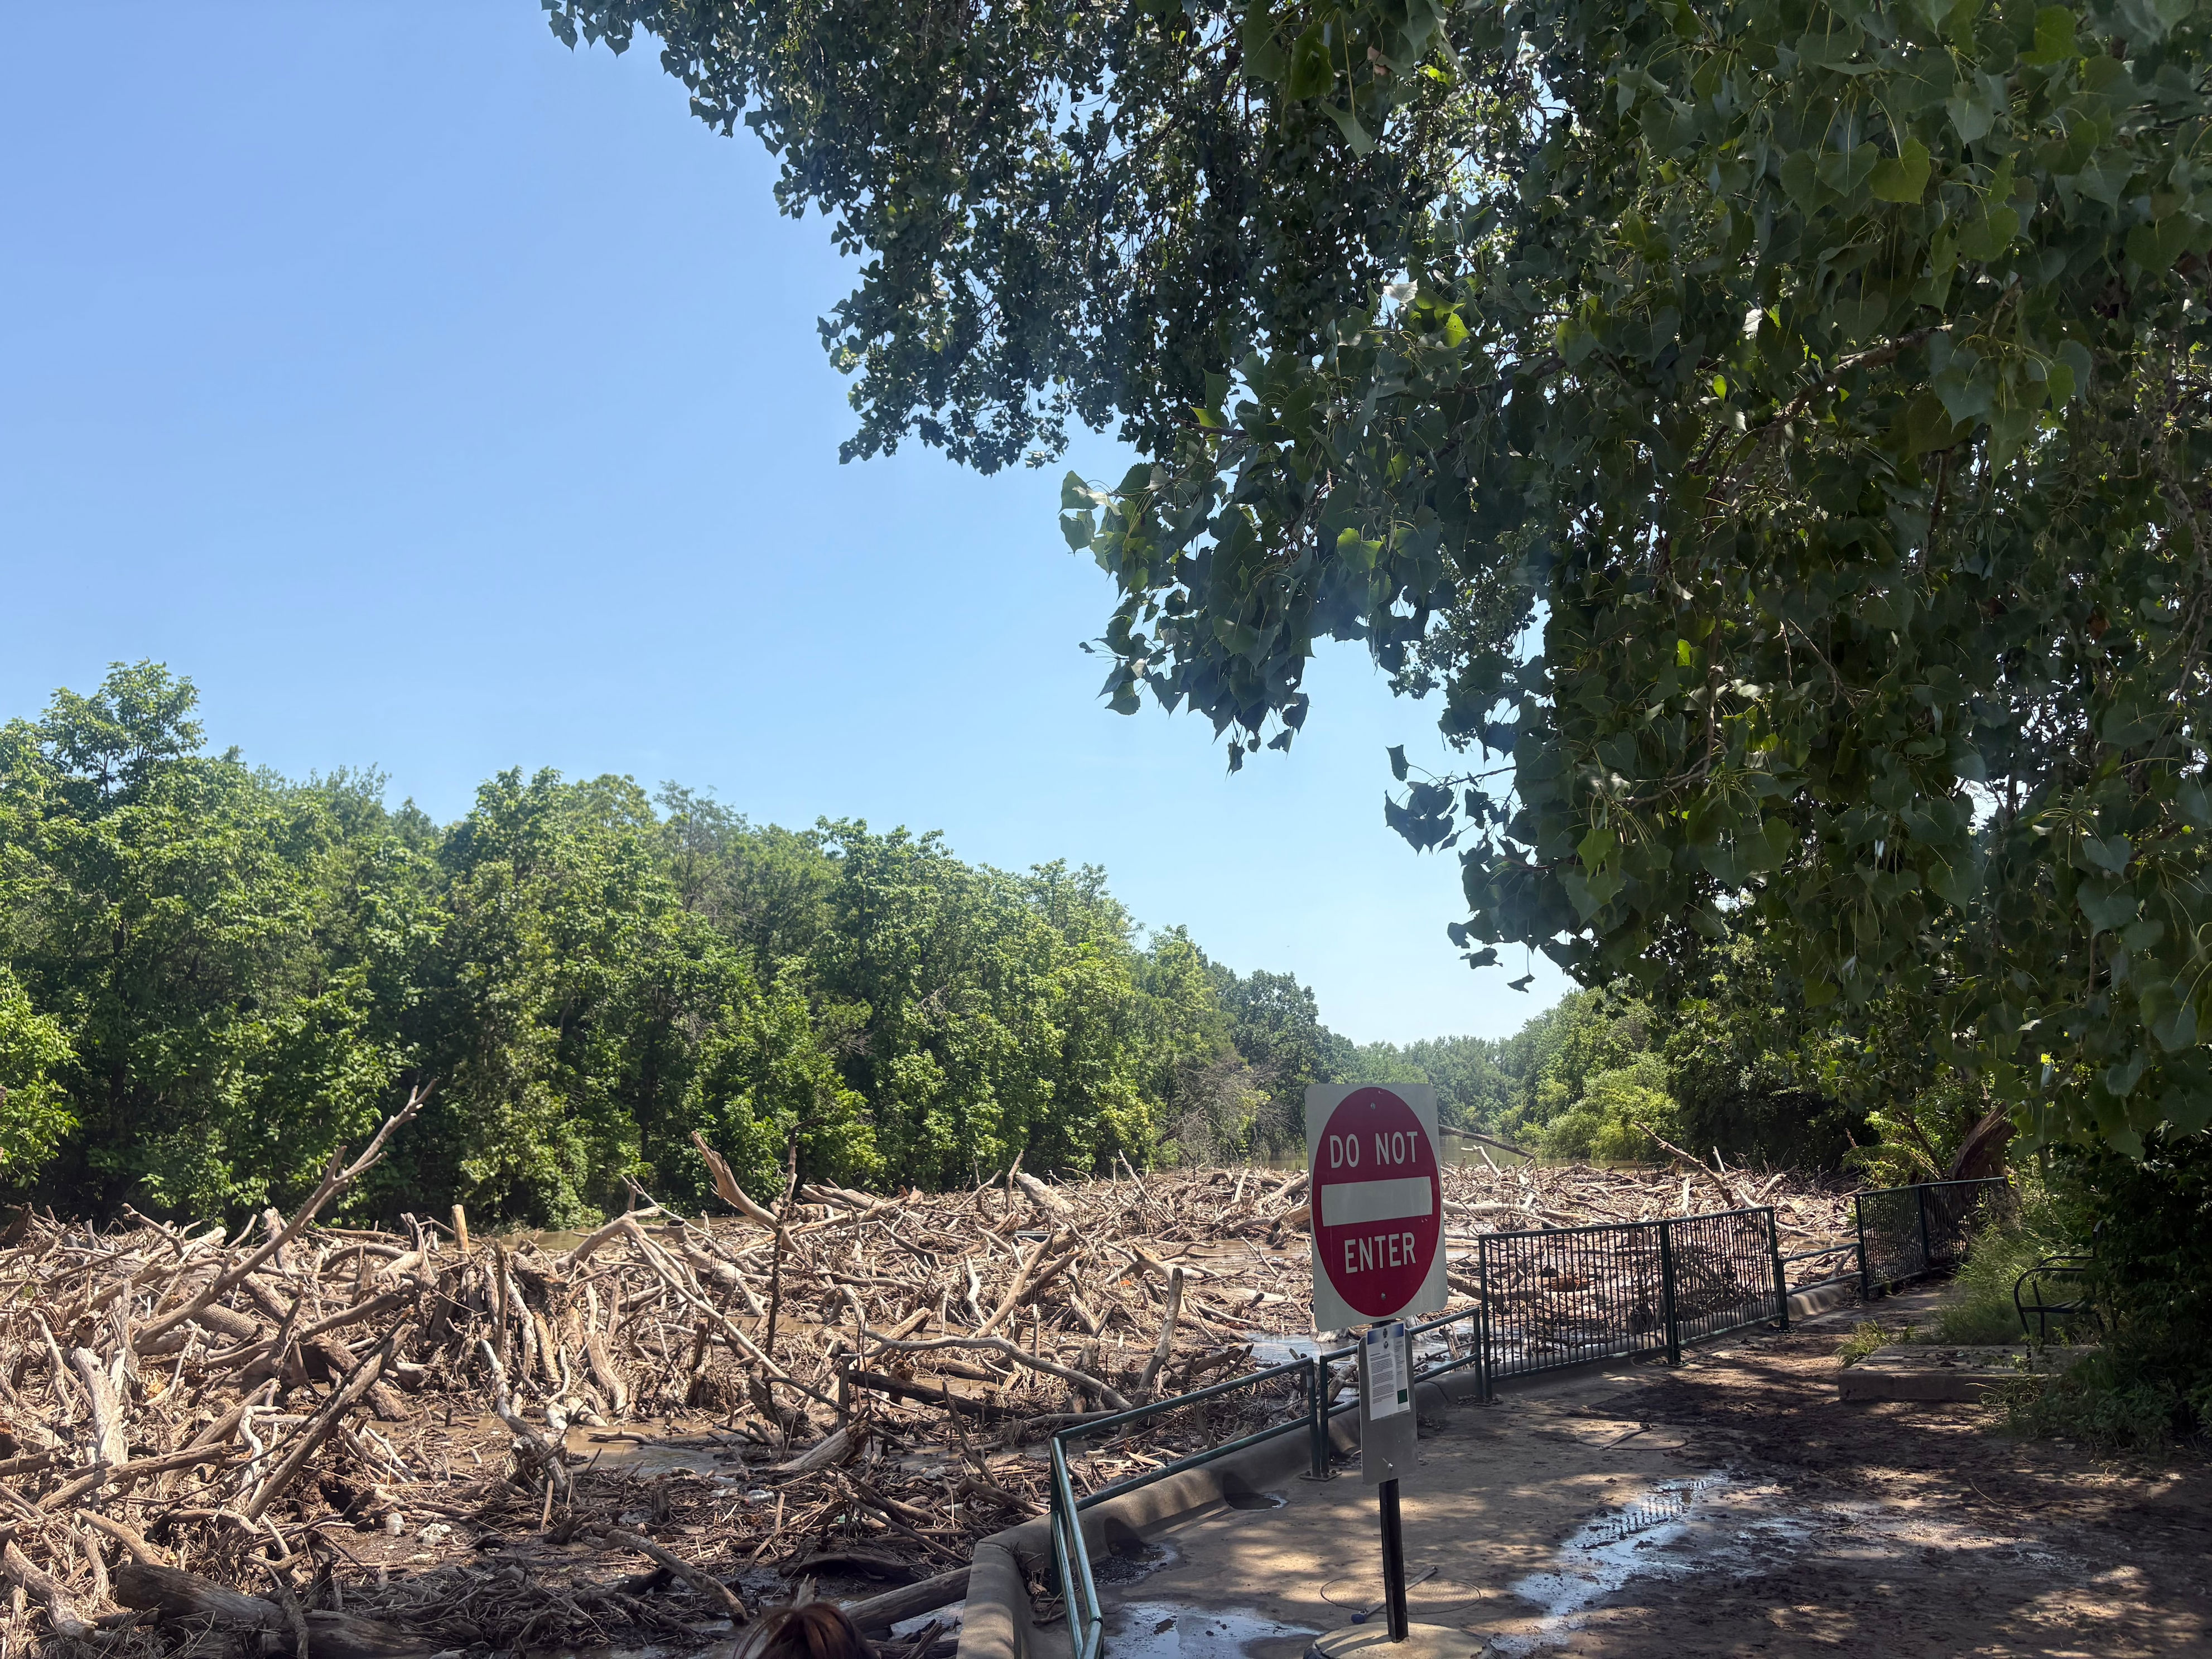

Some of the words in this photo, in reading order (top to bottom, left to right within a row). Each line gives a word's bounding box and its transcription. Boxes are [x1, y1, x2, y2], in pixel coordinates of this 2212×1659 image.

[1329, 1134, 1359, 1168] DO
[1375, 1131, 1418, 1165] NOT
[1344, 1232, 1416, 1274] ENTER
